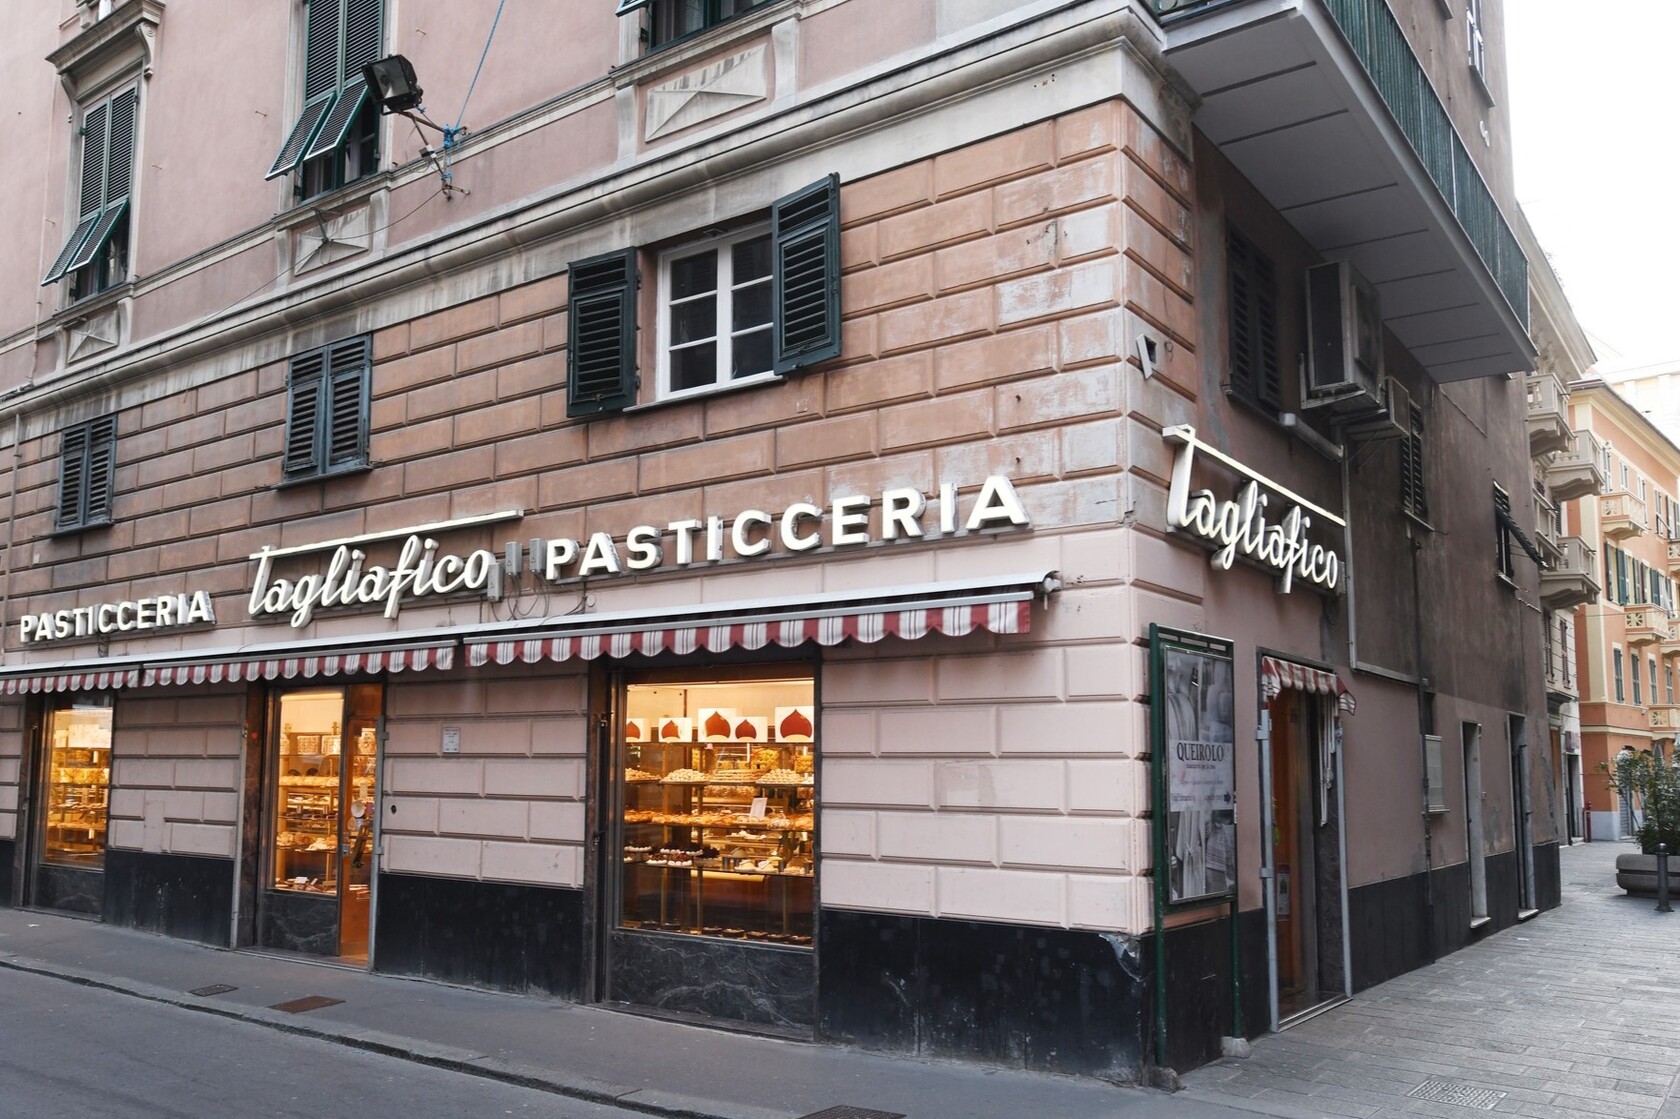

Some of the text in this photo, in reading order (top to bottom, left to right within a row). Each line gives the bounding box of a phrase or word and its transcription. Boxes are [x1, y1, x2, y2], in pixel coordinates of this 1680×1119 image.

[546, 475, 1029, 580] PASTICCERIA
[1163, 424, 1346, 593] Tagliafico
[20, 591, 214, 642] PASTICCERIA
[248, 510, 523, 628] Tagliafico
[1176, 742, 1224, 761] QUEIROLO
